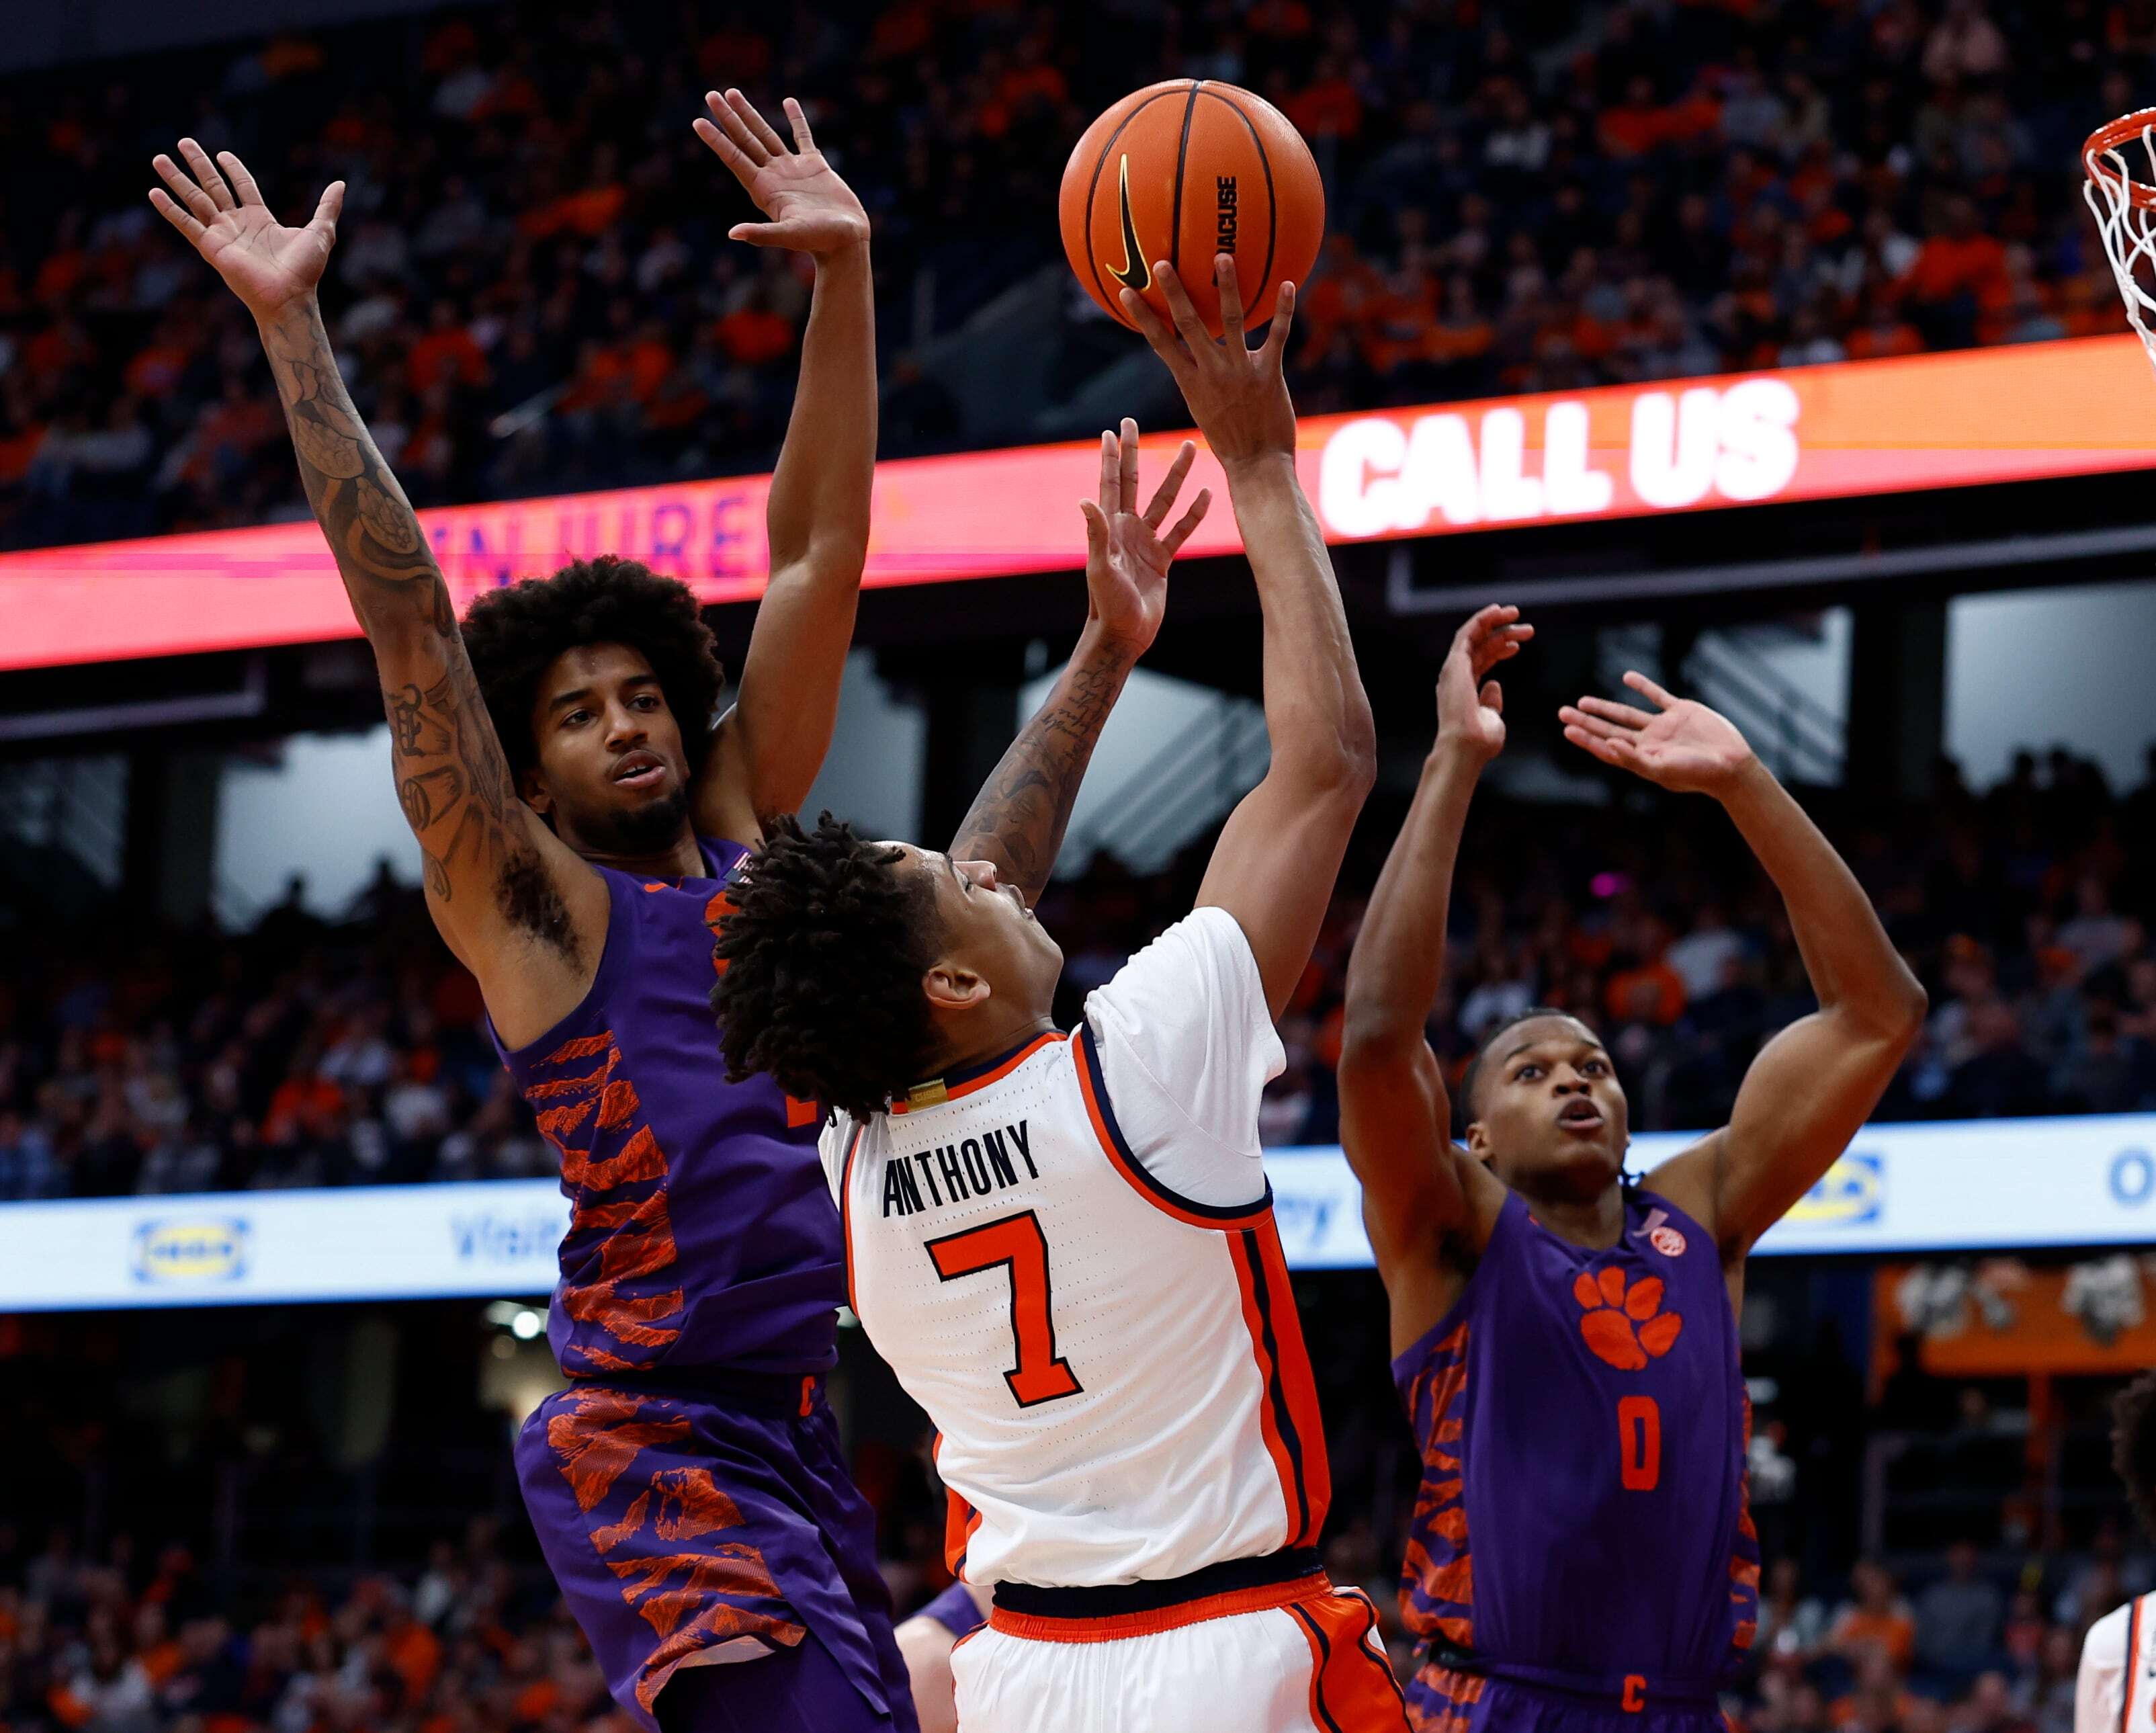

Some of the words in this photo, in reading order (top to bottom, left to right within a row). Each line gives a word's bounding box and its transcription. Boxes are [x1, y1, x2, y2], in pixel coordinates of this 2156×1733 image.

[1216, 176, 1237, 253] ACUSE
[1320, 411, 1612, 538] CALL
[1631, 378, 1800, 508] US
[883, 1119, 1039, 1218] ANTHONY
[923, 1208, 1084, 1408] 7
[799, 1376, 816, 1417] C
[1617, 1395, 1661, 1491] 0
[1621, 1673, 1647, 1714] C
